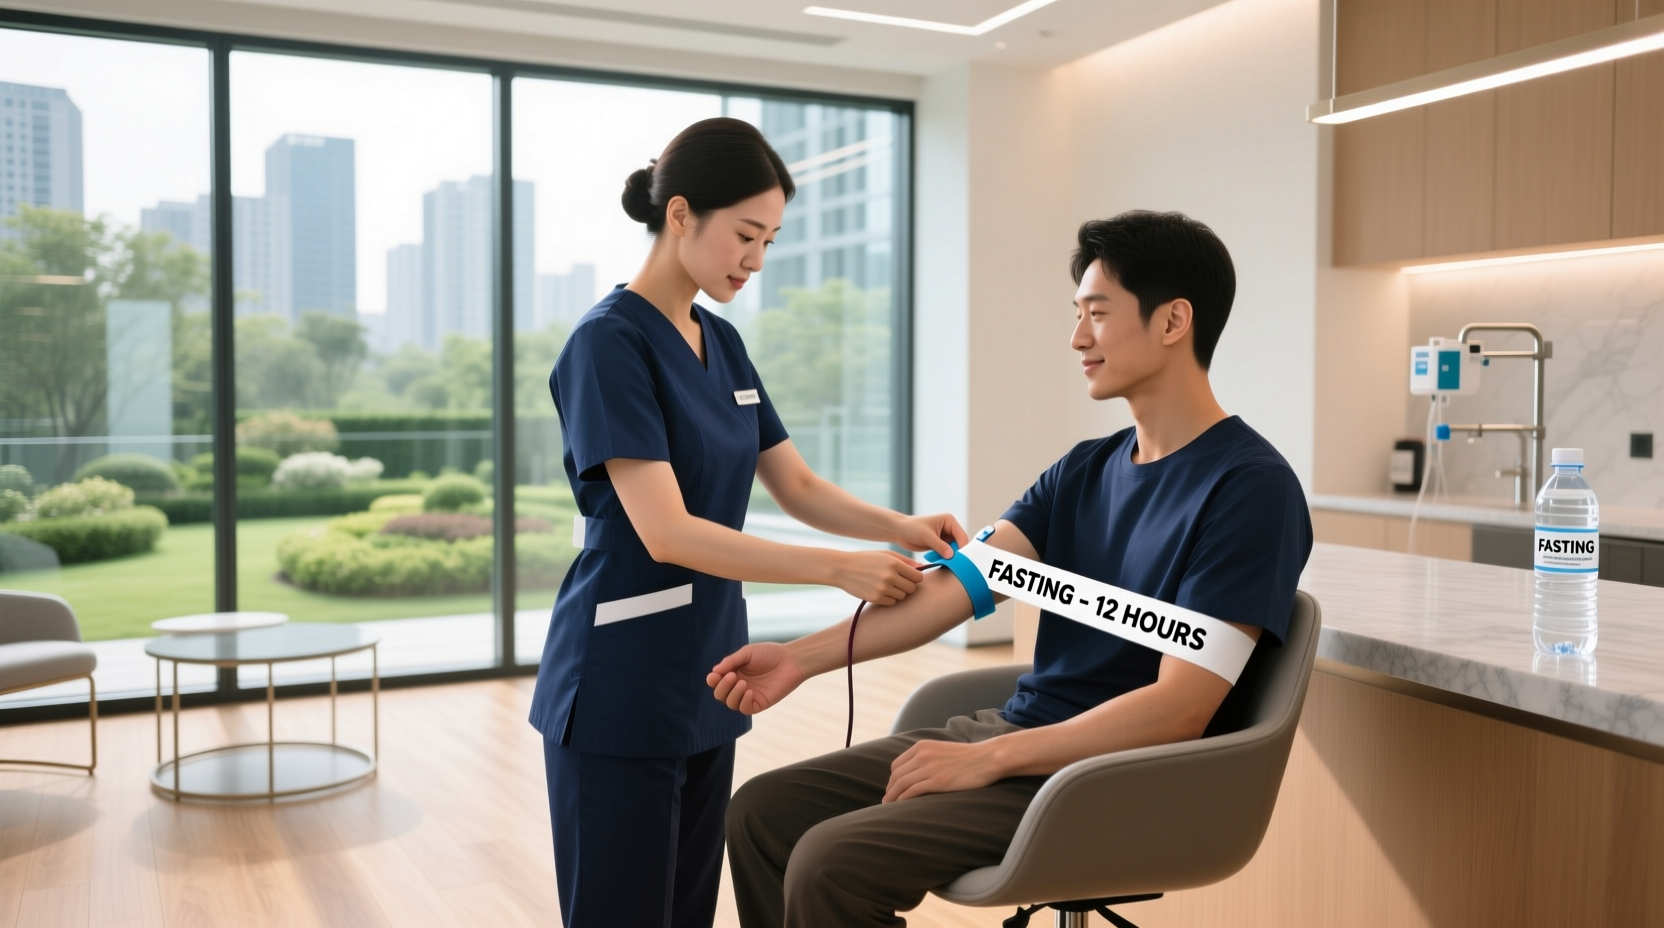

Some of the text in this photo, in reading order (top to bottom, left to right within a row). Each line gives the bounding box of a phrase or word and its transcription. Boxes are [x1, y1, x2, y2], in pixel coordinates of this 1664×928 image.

[1538, 538, 1595, 554] FASTING
[988, 558, 1075, 606] FASTING
[1096, 595, 1119, 622] 12
[1121, 604, 1207, 651] HOURS
